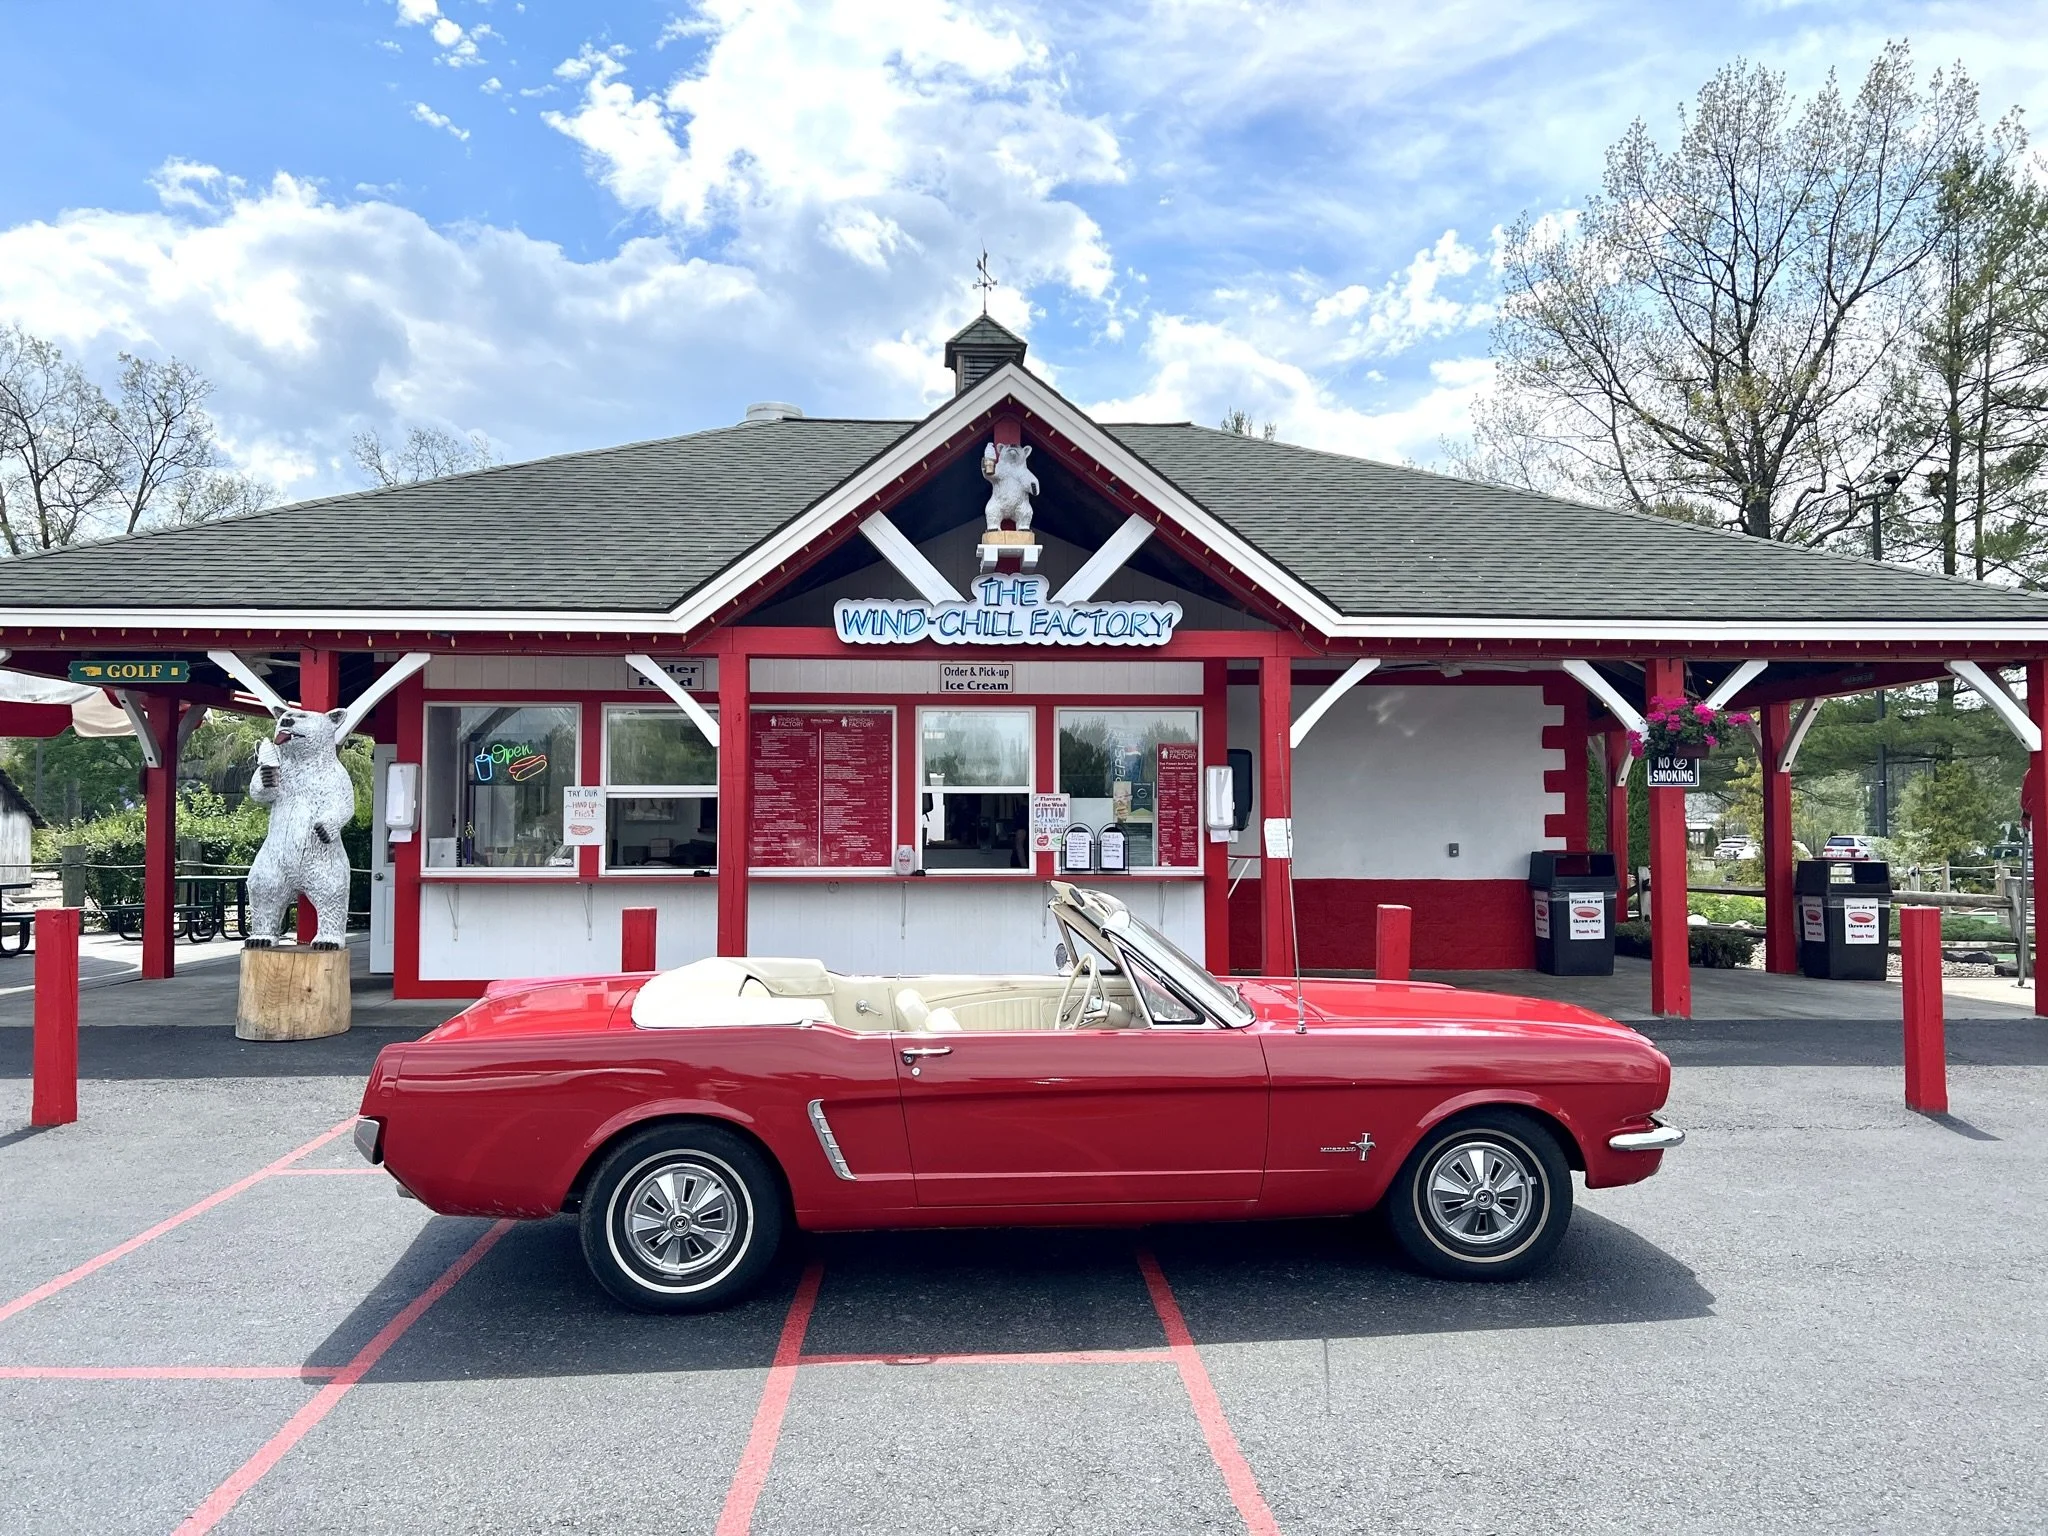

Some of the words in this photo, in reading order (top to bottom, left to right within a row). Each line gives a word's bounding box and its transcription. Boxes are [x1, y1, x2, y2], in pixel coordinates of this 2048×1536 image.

[980, 577, 1039, 606] THE
[1030, 608, 1174, 638] FACTORY
[106, 664, 162, 678] GOLF
[632, 664, 699, 674] der
[944, 666, 968, 677] Order
[970, 666, 977, 677] &
[979, 666, 1010, 679] Pick-up
[638, 677, 693, 687] Fd
[945, 680, 964, 690] Ice
[967, 680, 1009, 690] Cream
[491, 744, 533, 764] Open
[1658, 757, 1670, 769] NO
[1653, 770, 1694, 782] SMOKING
